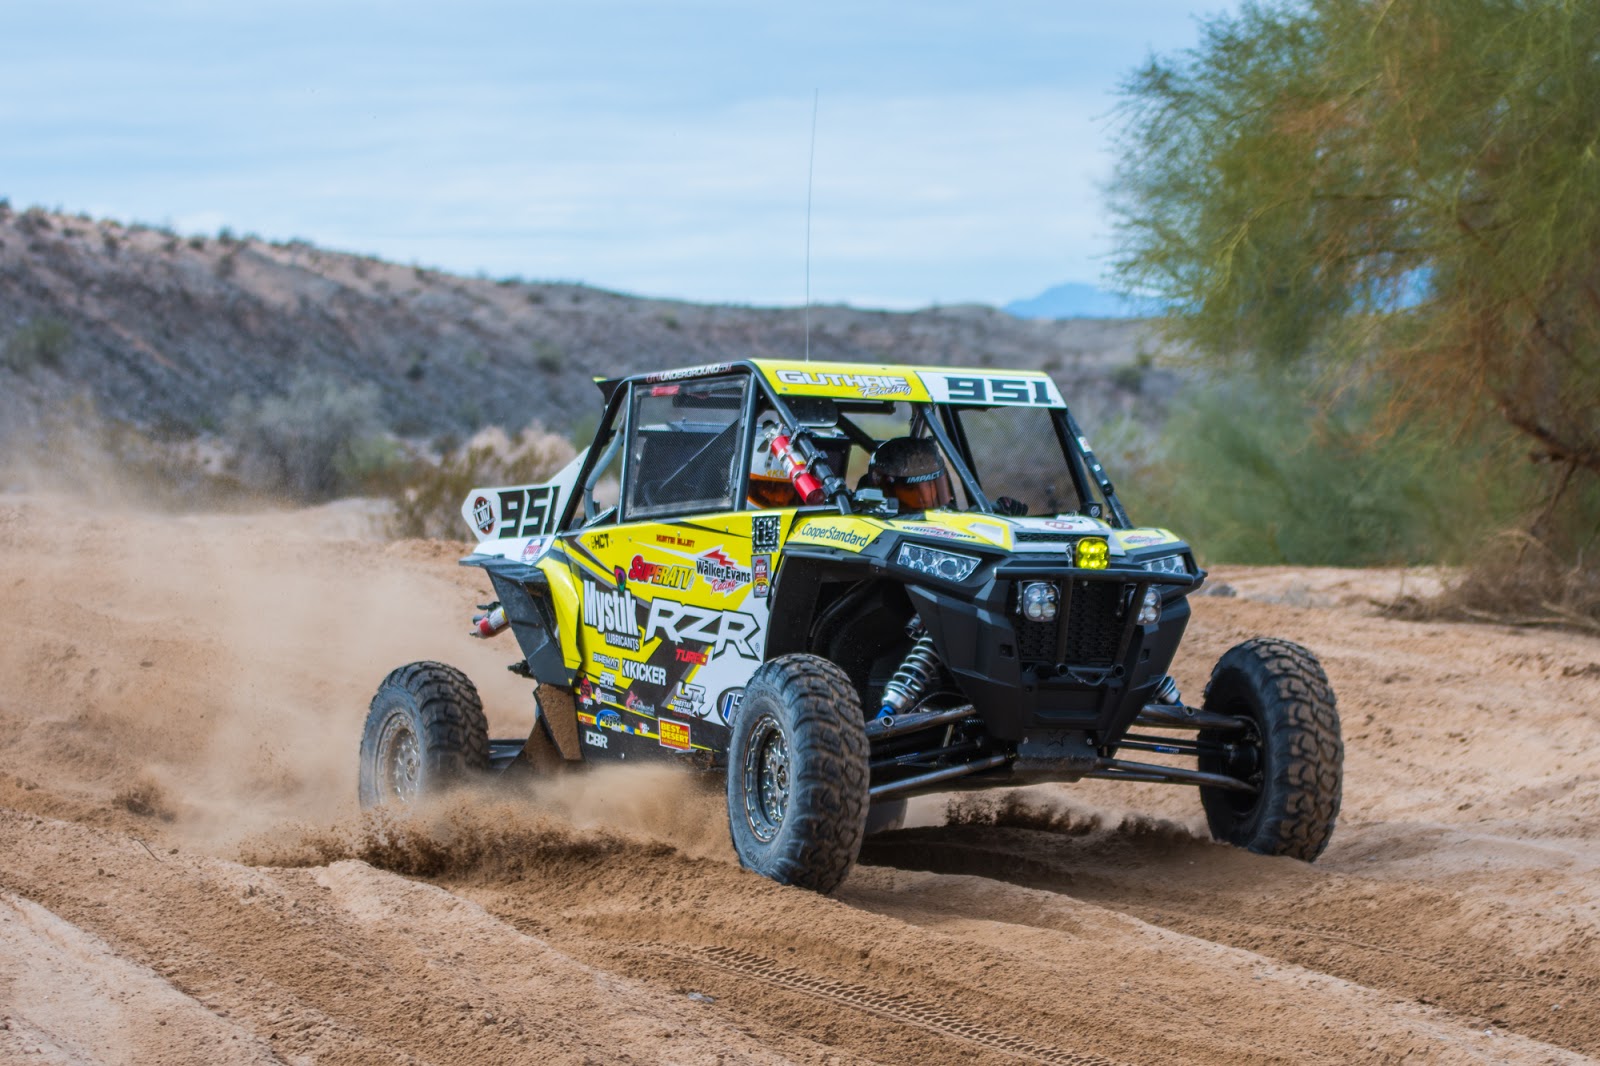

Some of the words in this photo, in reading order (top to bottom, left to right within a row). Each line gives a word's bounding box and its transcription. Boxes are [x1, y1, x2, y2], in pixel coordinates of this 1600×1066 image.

[776, 370, 908, 388] GUTHRIE
[858, 384, 911, 398] Racing
[944, 376, 1052, 404] 951
[906, 470, 941, 484] IMPACT
[497, 486, 560, 539] 951
[802, 523, 872, 547] CooperStandard
[628, 555, 693, 589] SUPERATV
[725, 566, 751, 583] Evans
[643, 596, 761, 661] RZR
[605, 632, 640, 651] LUBRICANTS
[676, 648, 708, 666] TURBO
[629, 661, 667, 686] KICKER
[660, 721, 680, 734] BEST
[661, 730, 689, 744] DESERT
[585, 730, 608, 749] CBR
